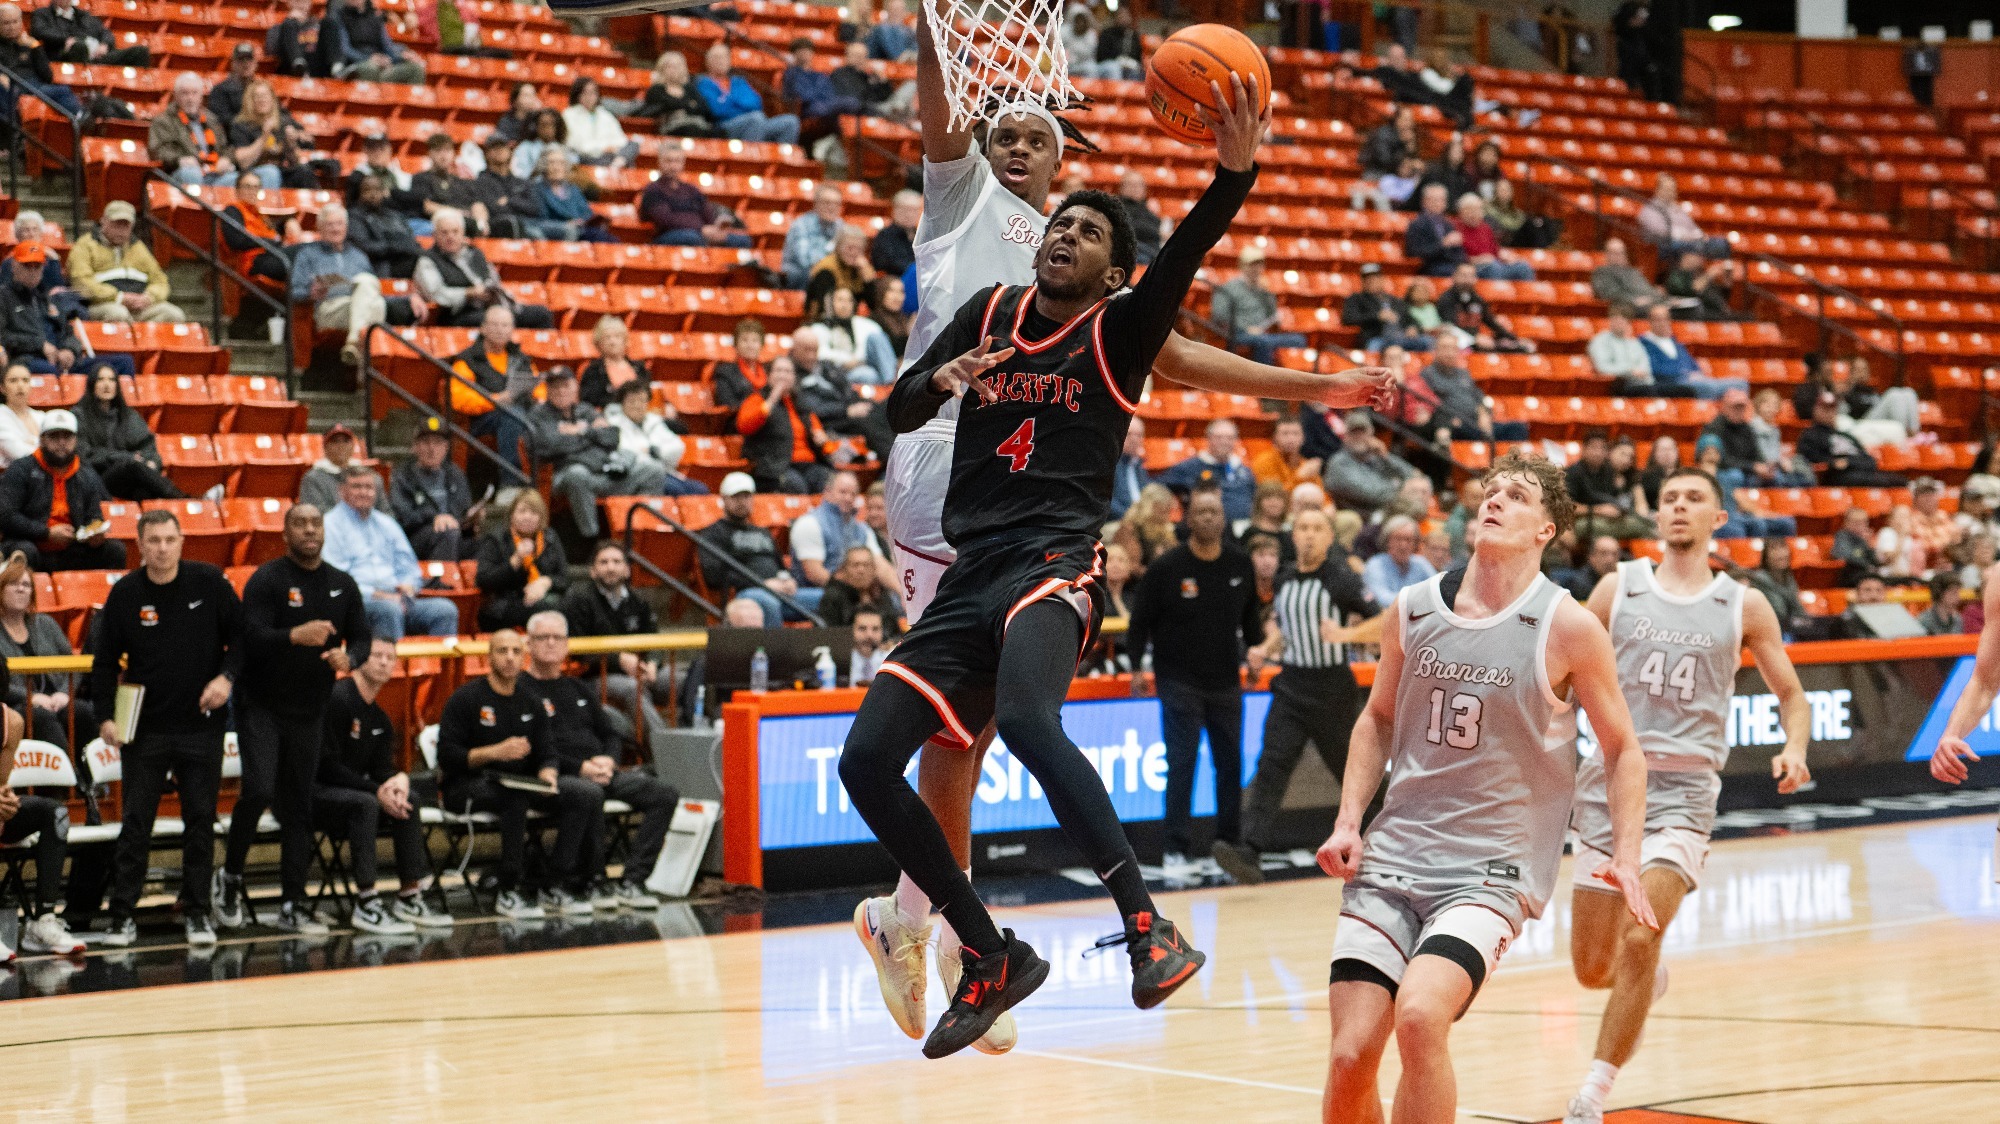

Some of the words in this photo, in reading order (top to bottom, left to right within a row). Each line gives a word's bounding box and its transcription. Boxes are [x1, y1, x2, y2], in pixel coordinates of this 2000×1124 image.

[1151, 90, 1207, 135] ELITE
[996, 417, 1036, 473] 4
[1629, 615, 1715, 649] Broncos
[1414, 645, 1514, 688] Broncos
[1638, 647, 1699, 703] 44
[1426, 686, 1484, 751] 13
[1726, 688, 1853, 748] THERE
[12, 751, 62, 771] CIFIC
